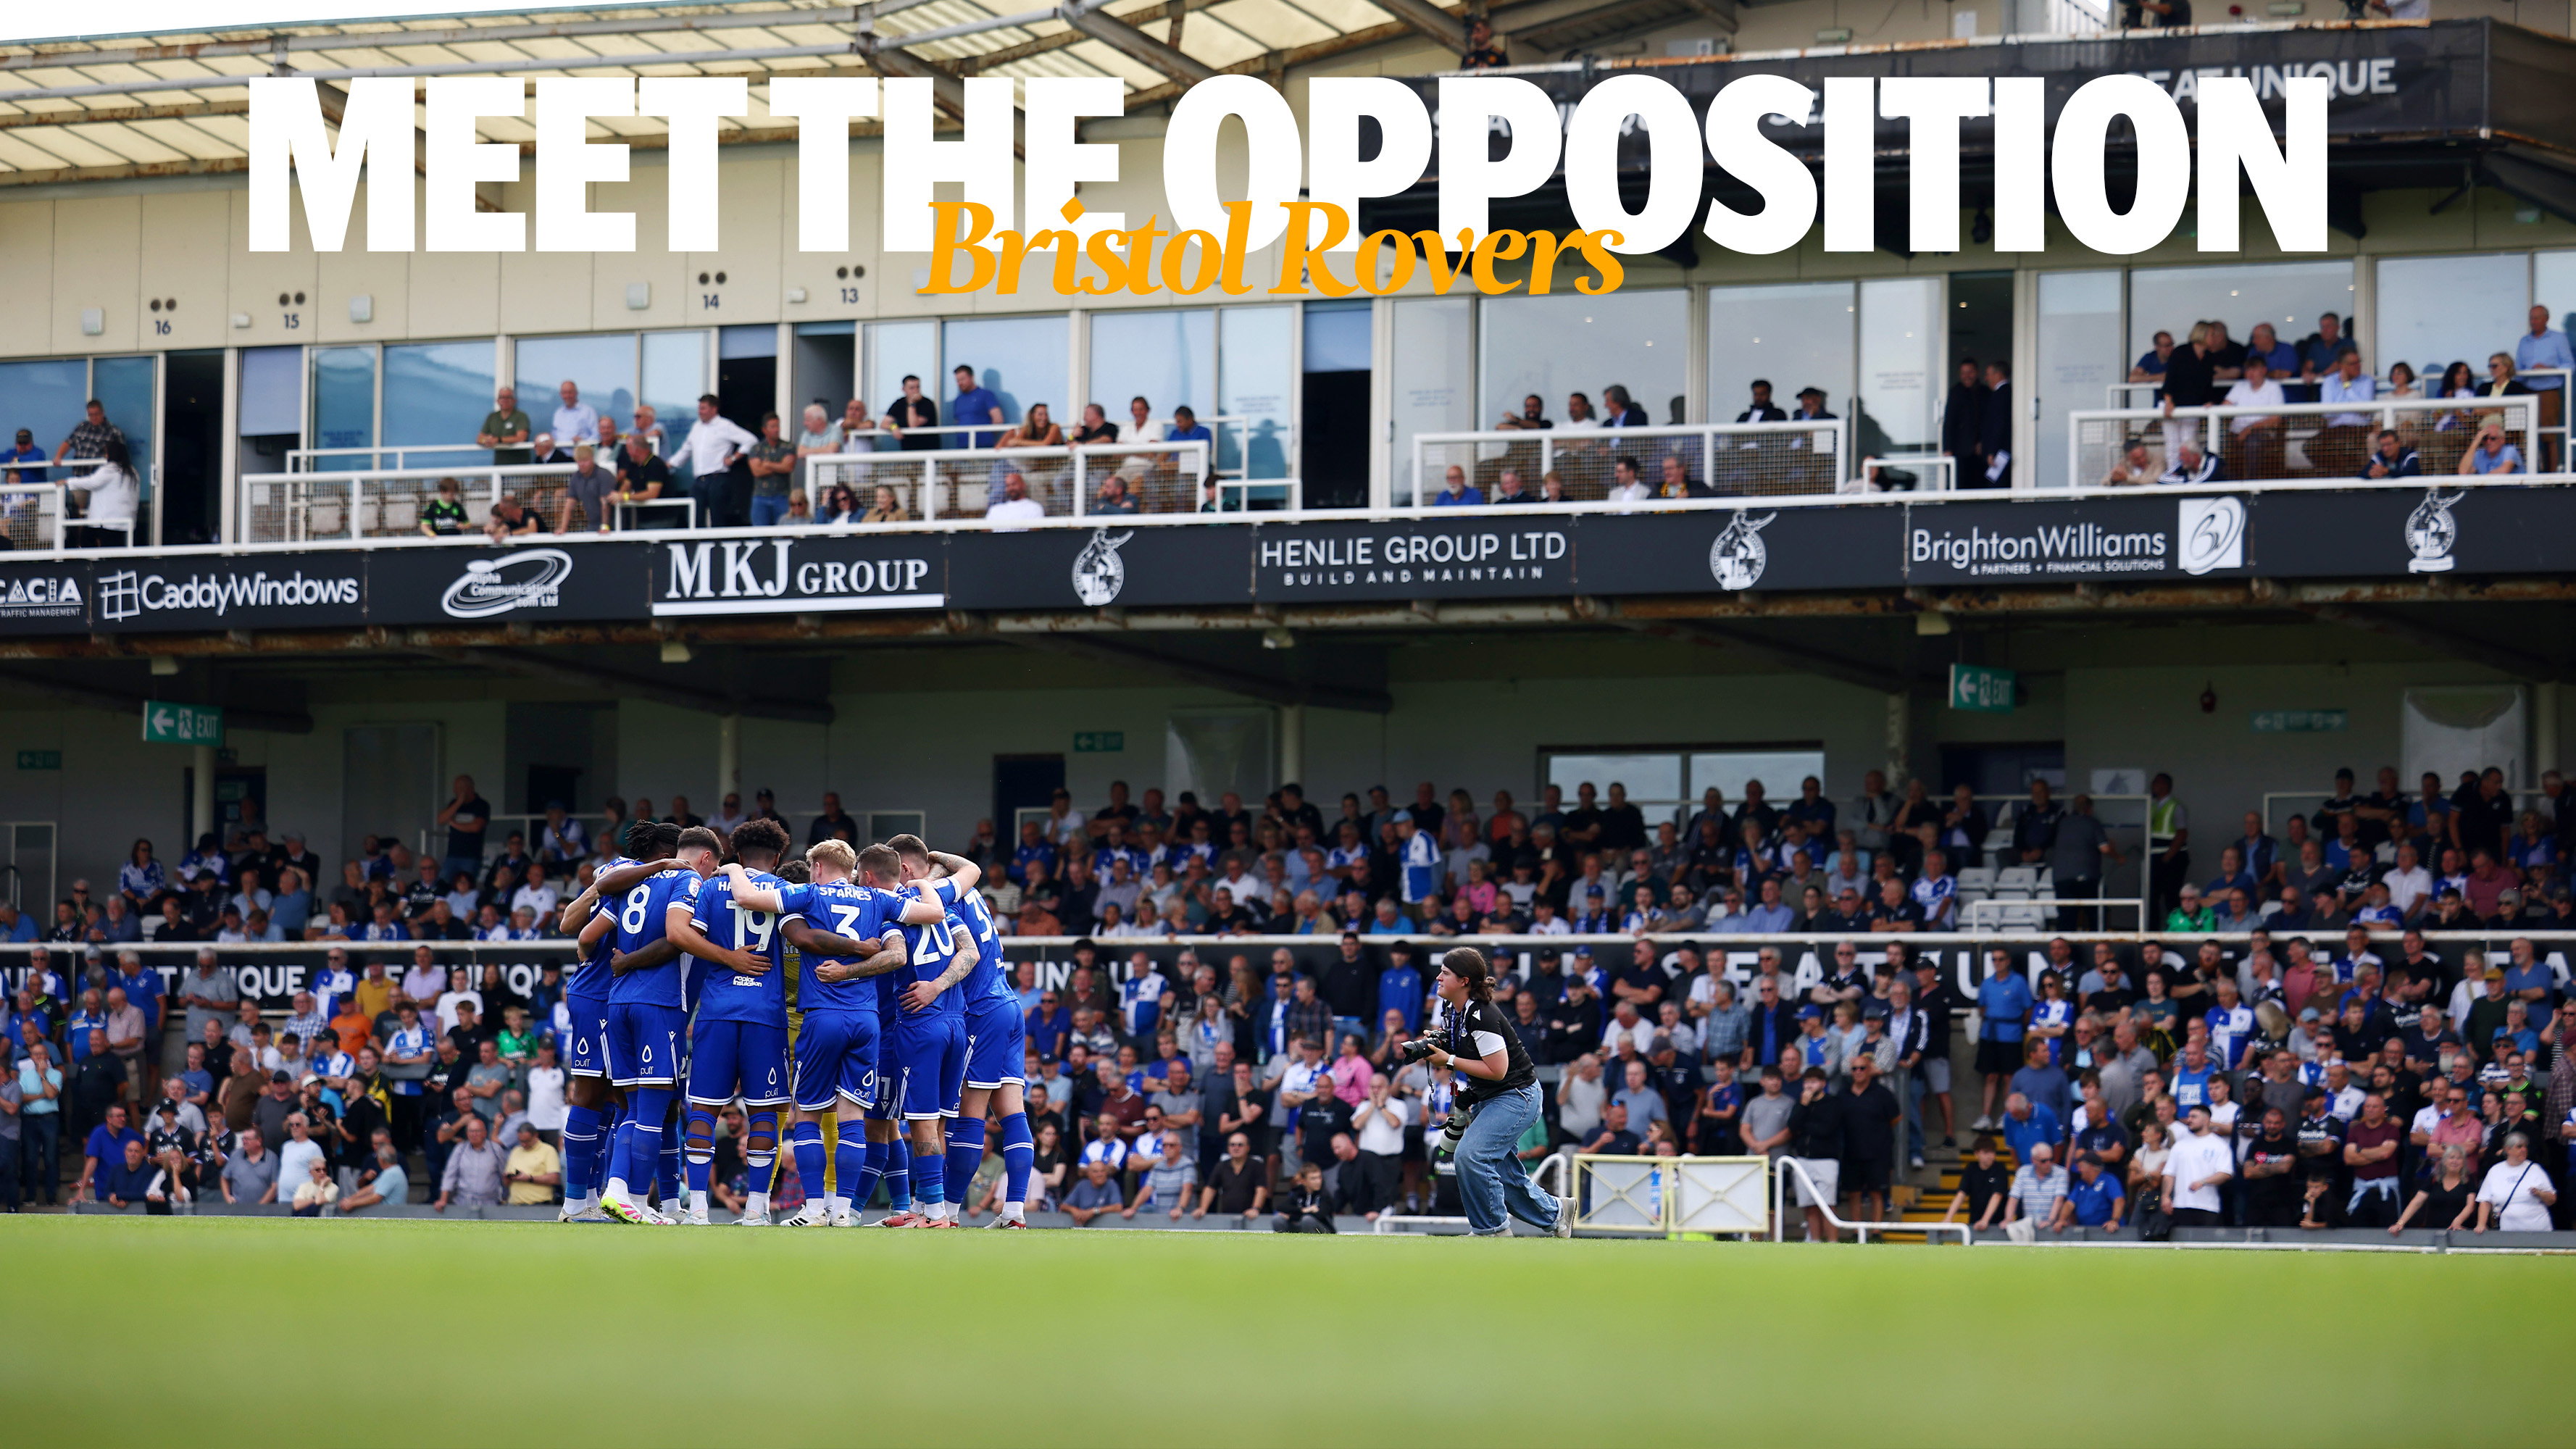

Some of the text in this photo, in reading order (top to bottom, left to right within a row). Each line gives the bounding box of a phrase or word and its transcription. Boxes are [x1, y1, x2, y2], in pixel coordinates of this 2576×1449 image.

[704, 295, 719, 308] 14
[842, 288, 858, 302] 13
[156, 321, 171, 334] 16
[284, 314, 299, 328] 15
[1261, 532, 1566, 567] HENLIE GROUP LTD
[665, 539, 929, 599] MKJ GROUP
[1980, 561, 2032, 575] PARTNERS
[2046, 559, 2102, 574] FINANCIAL
[2104, 557, 2165, 572] SOLUTIONS
[1283, 566, 1543, 586] BUILD AND MAINTAIN
[141, 571, 359, 617] CaddyWindows
[29, 608, 81, 617] MANAGEMENT
[1993, 678, 2012, 706] EXIT
[197, 714, 218, 739] EXIT
[718, 881, 775, 892] HASON
[819, 887, 872, 901] SPARKES
[622, 884, 651, 934] 8
[726, 900, 775, 951] 19
[831, 904, 861, 953] 3
[913, 918, 955, 966] 20
[575, 1058, 591, 1068] puff
[641, 1066, 654, 1076] puff
[765, 1087, 779, 1099] puff
[854, 1087, 872, 1100] puff
